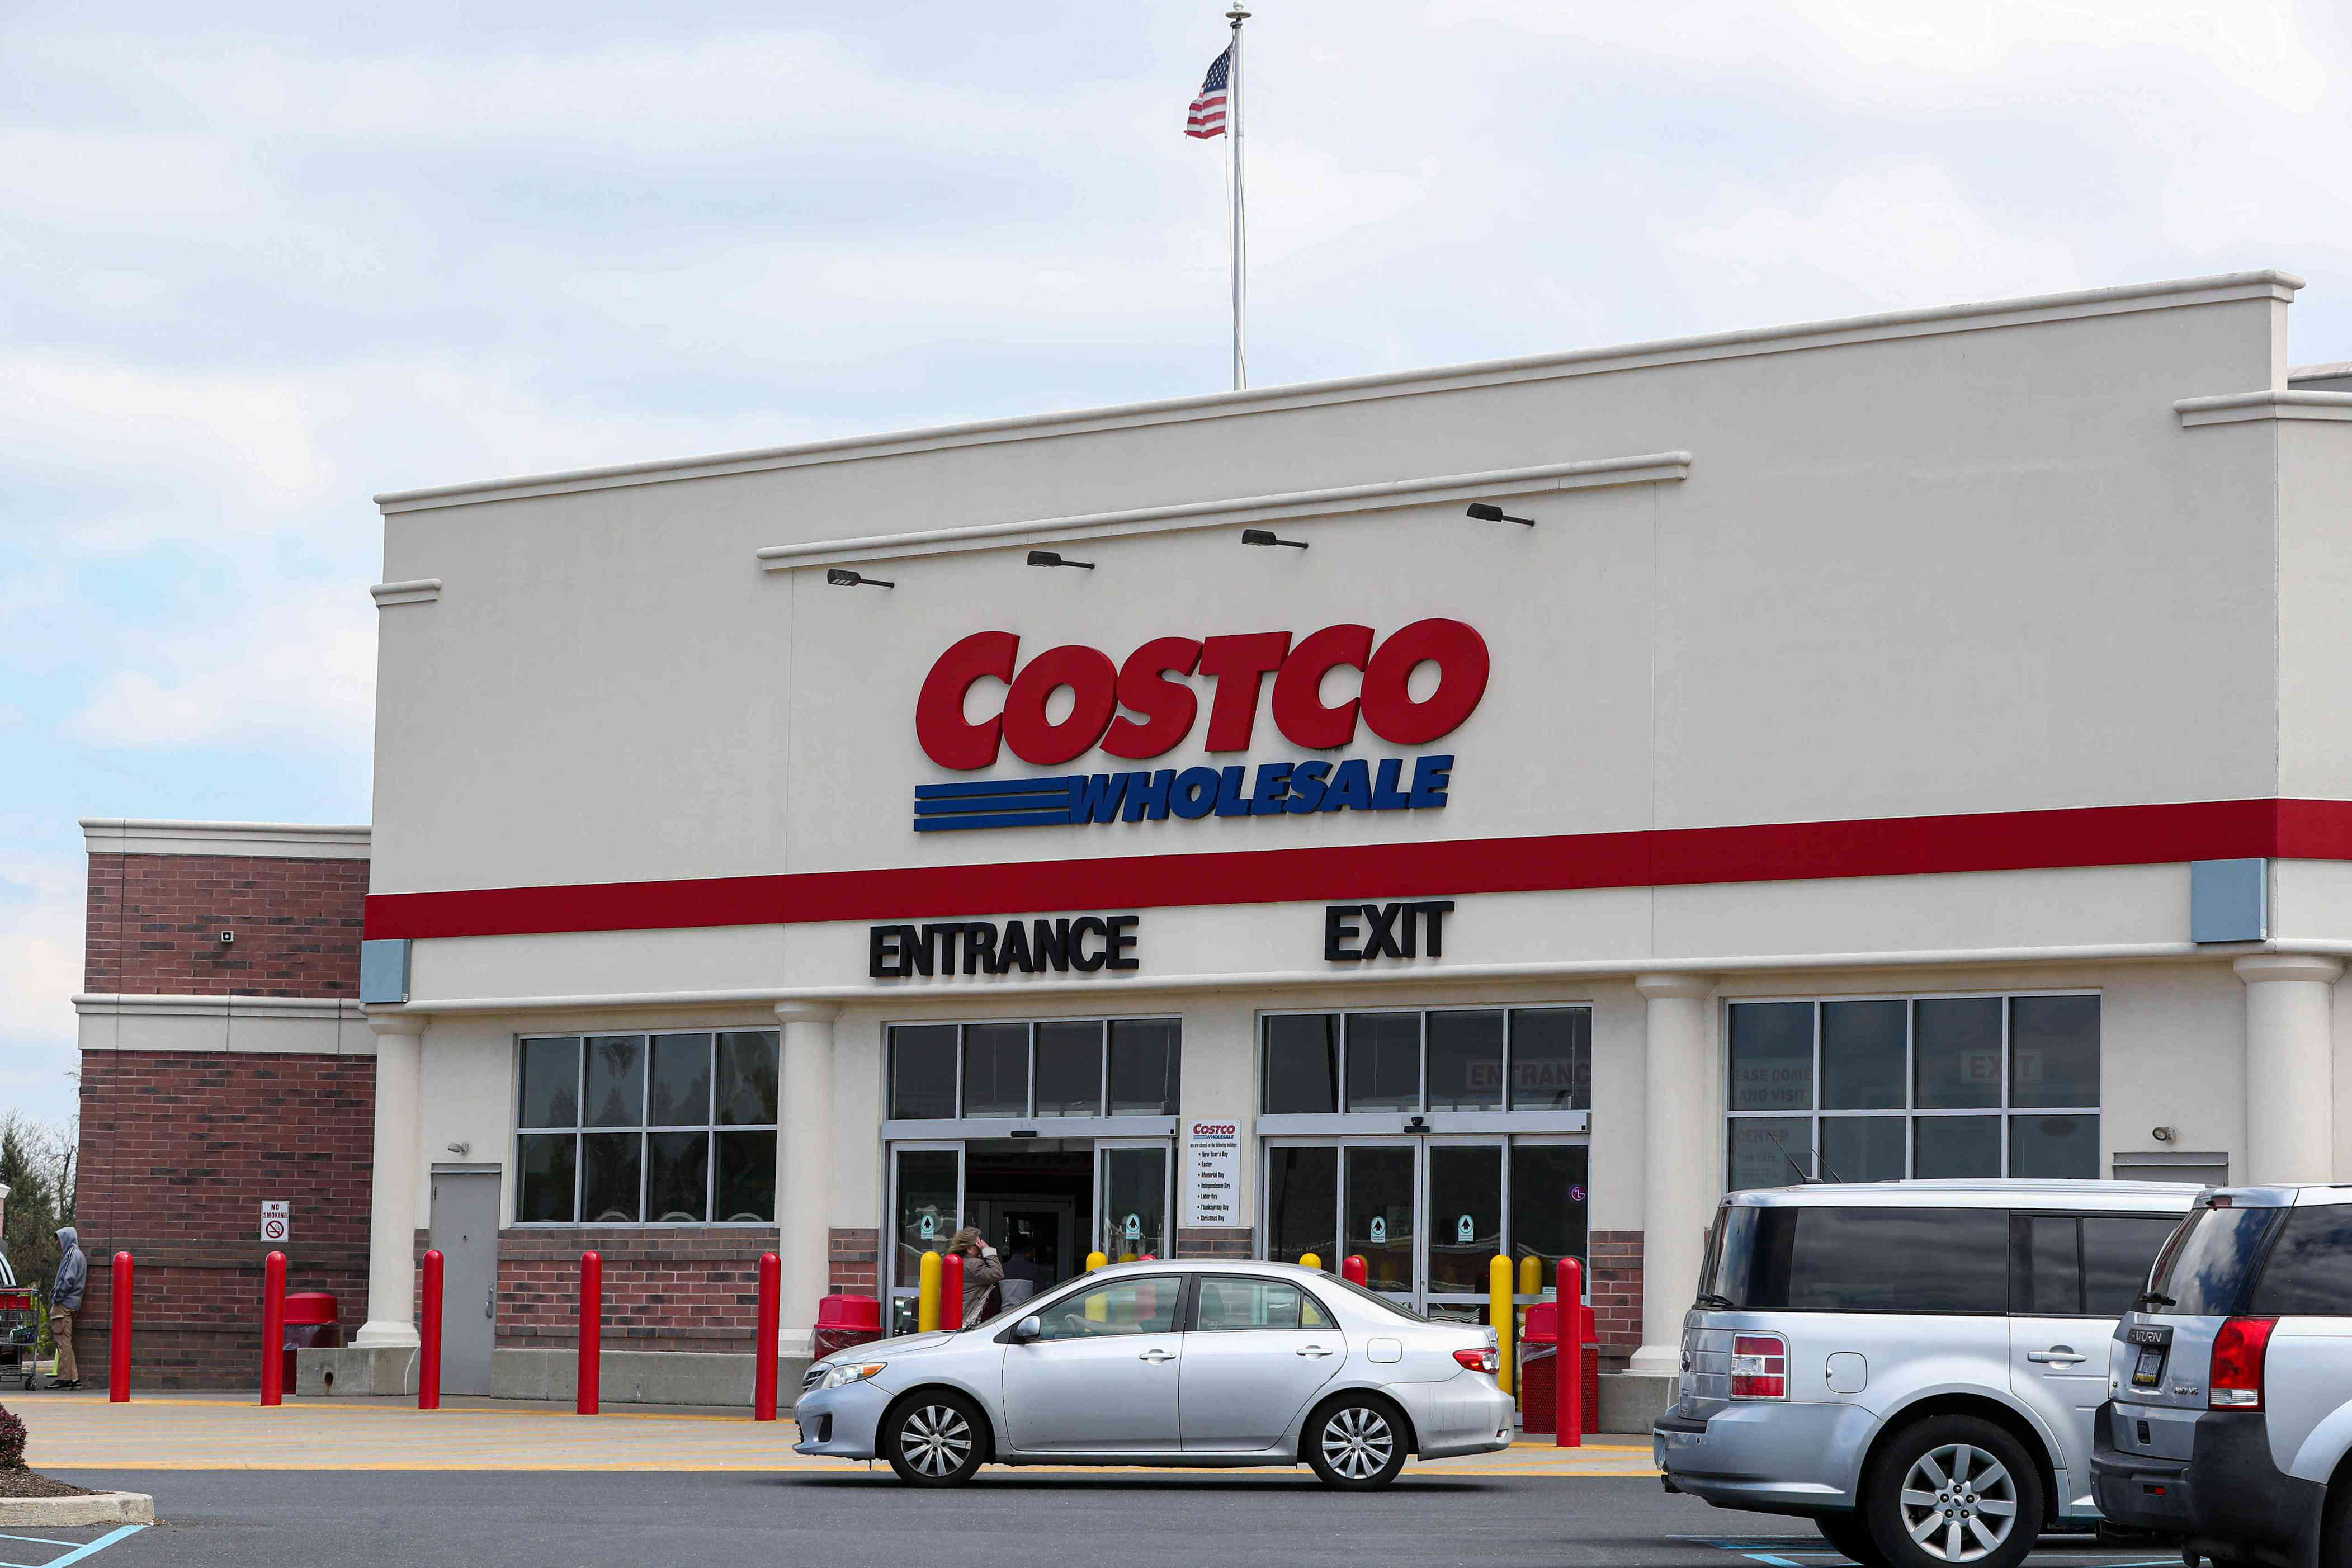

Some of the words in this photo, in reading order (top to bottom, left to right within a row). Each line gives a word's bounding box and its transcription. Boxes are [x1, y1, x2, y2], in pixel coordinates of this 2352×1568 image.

[915, 617, 1490, 770] COSTCO
[1069, 755, 1454, 824] WHOLESALE
[1324, 900, 1454, 961] EXIT
[870, 915, 1139, 977] ENTRANCE
[1471, 1063, 1591, 1085] ENRANC
[1735, 1069, 1768, 1082] EASE
[1971, 1055, 2034, 1078] EXT
[1771, 1088, 1805, 1102] VISIT
[1193, 1123, 1235, 1134] COSTCO
